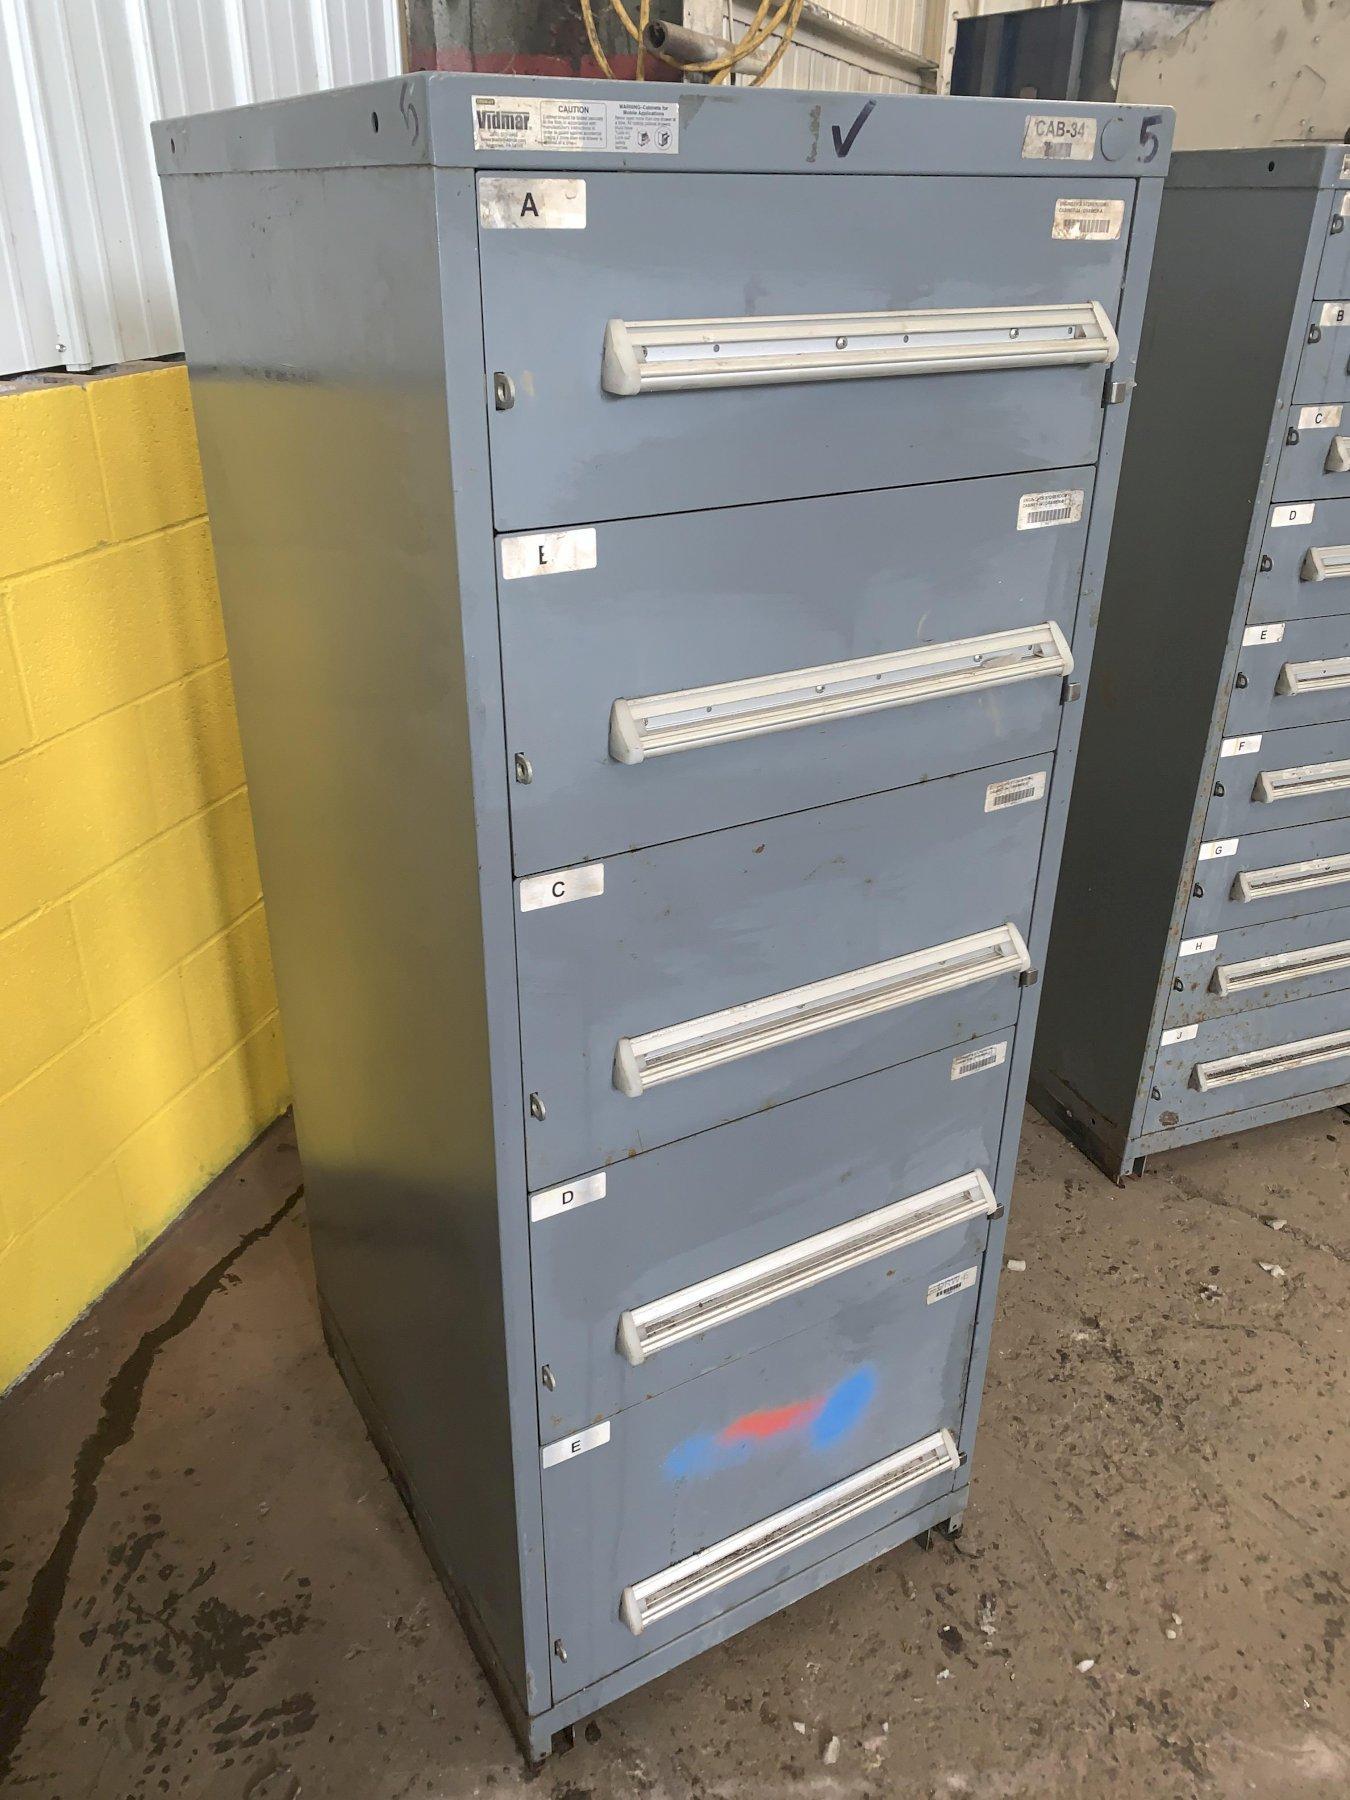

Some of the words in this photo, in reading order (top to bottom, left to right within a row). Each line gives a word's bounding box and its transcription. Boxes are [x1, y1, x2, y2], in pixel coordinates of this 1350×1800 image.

[558, 105, 590, 114] CAUTION
[476, 110, 530, 130] Vidmar
[1035, 119, 1086, 138] CAB-34
[1137, 114, 1163, 164] 5
[520, 192, 539, 217] A
[1336, 310, 1344, 322] B
[1315, 413, 1323, 424] C
[1288, 510, 1297, 521] D
[1260, 629, 1268, 640] E
[1238, 741, 1246, 751] F
[1214, 846, 1223, 855] G
[551, 881, 566, 898] C
[1195, 941, 1203, 950] H
[1176, 1031, 1183, 1040] J
[562, 1190, 574, 1205] D
[571, 1440, 581, 1453] E
